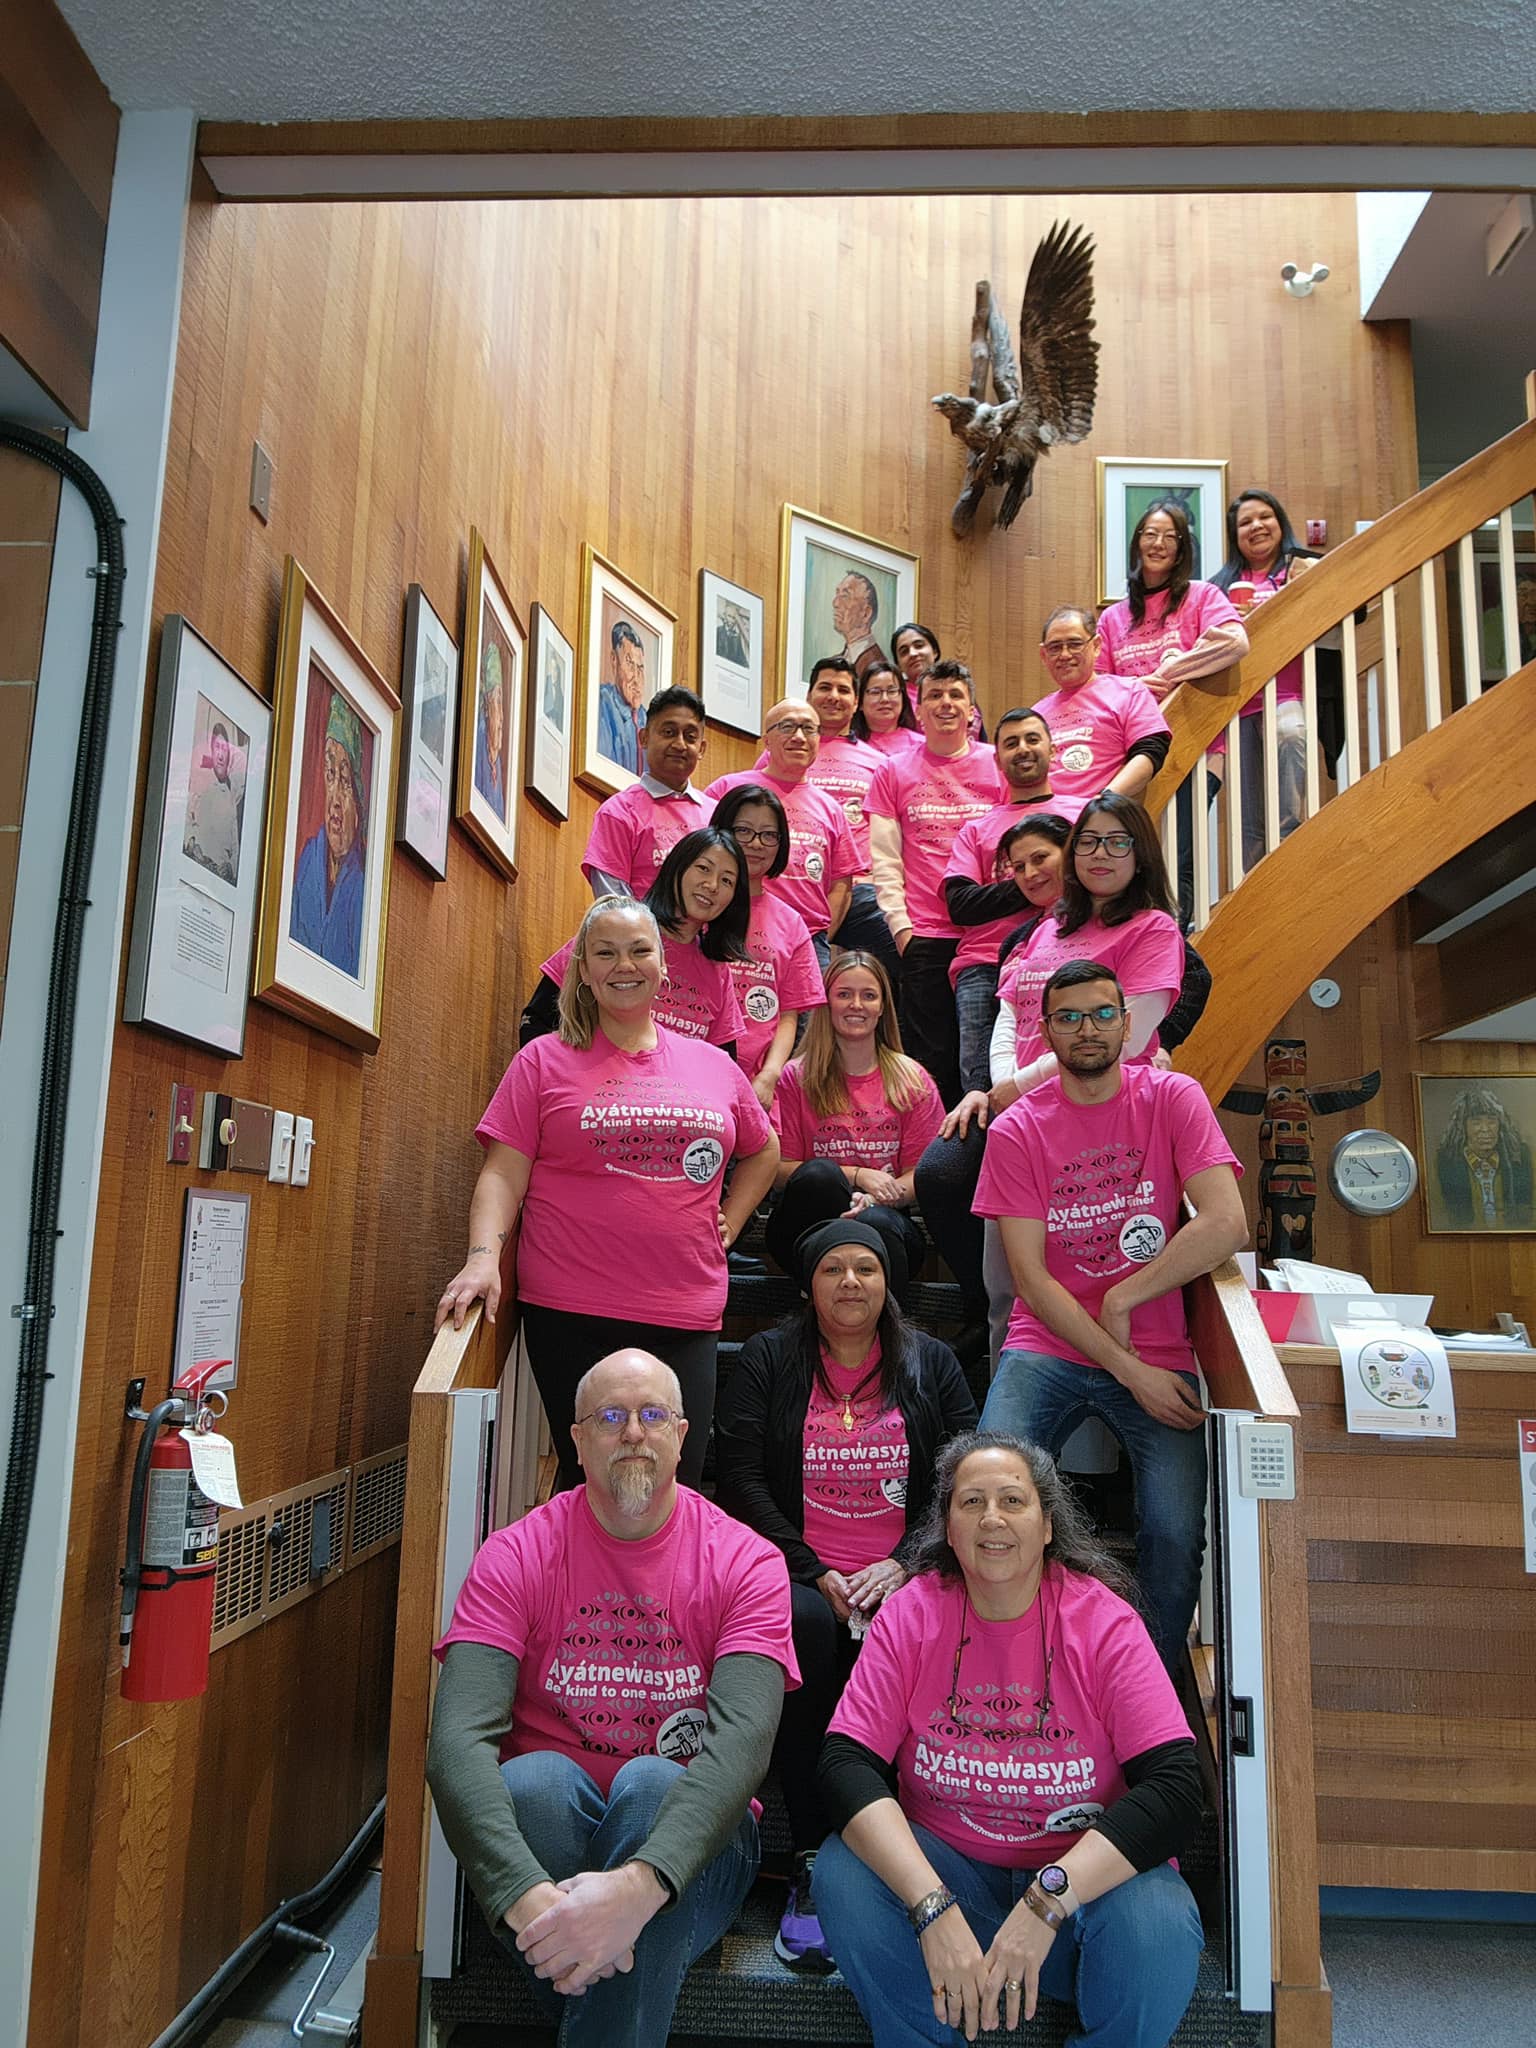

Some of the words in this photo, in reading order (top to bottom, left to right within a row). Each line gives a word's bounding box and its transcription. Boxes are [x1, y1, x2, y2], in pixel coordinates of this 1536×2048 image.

[581, 1119, 598, 1130] Be
[603, 1117, 631, 1128] kind
[636, 1118, 650, 1127] to
[653, 1118, 677, 1127] one
[682, 1119, 725, 1133] another
[1048, 1223, 1064, 1232] Be
[1066, 1219, 1093, 1230] kind
[1096, 1216, 1108, 1225] to
[831, 1462, 844, 1471] to
[848, 1462, 872, 1471] one
[545, 1678, 562, 1694] Be
[566, 1684, 597, 1698] kind
[601, 1686, 617, 1698] to
[621, 1688, 647, 1699] one
[650, 1684, 704, 1702] another
[913, 1762, 931, 1780] Be
[935, 1770, 970, 1789] kind
[974, 1778, 993, 1793] to
[997, 1783, 1028, 1795] one
[1034, 1776, 1097, 1796] another
